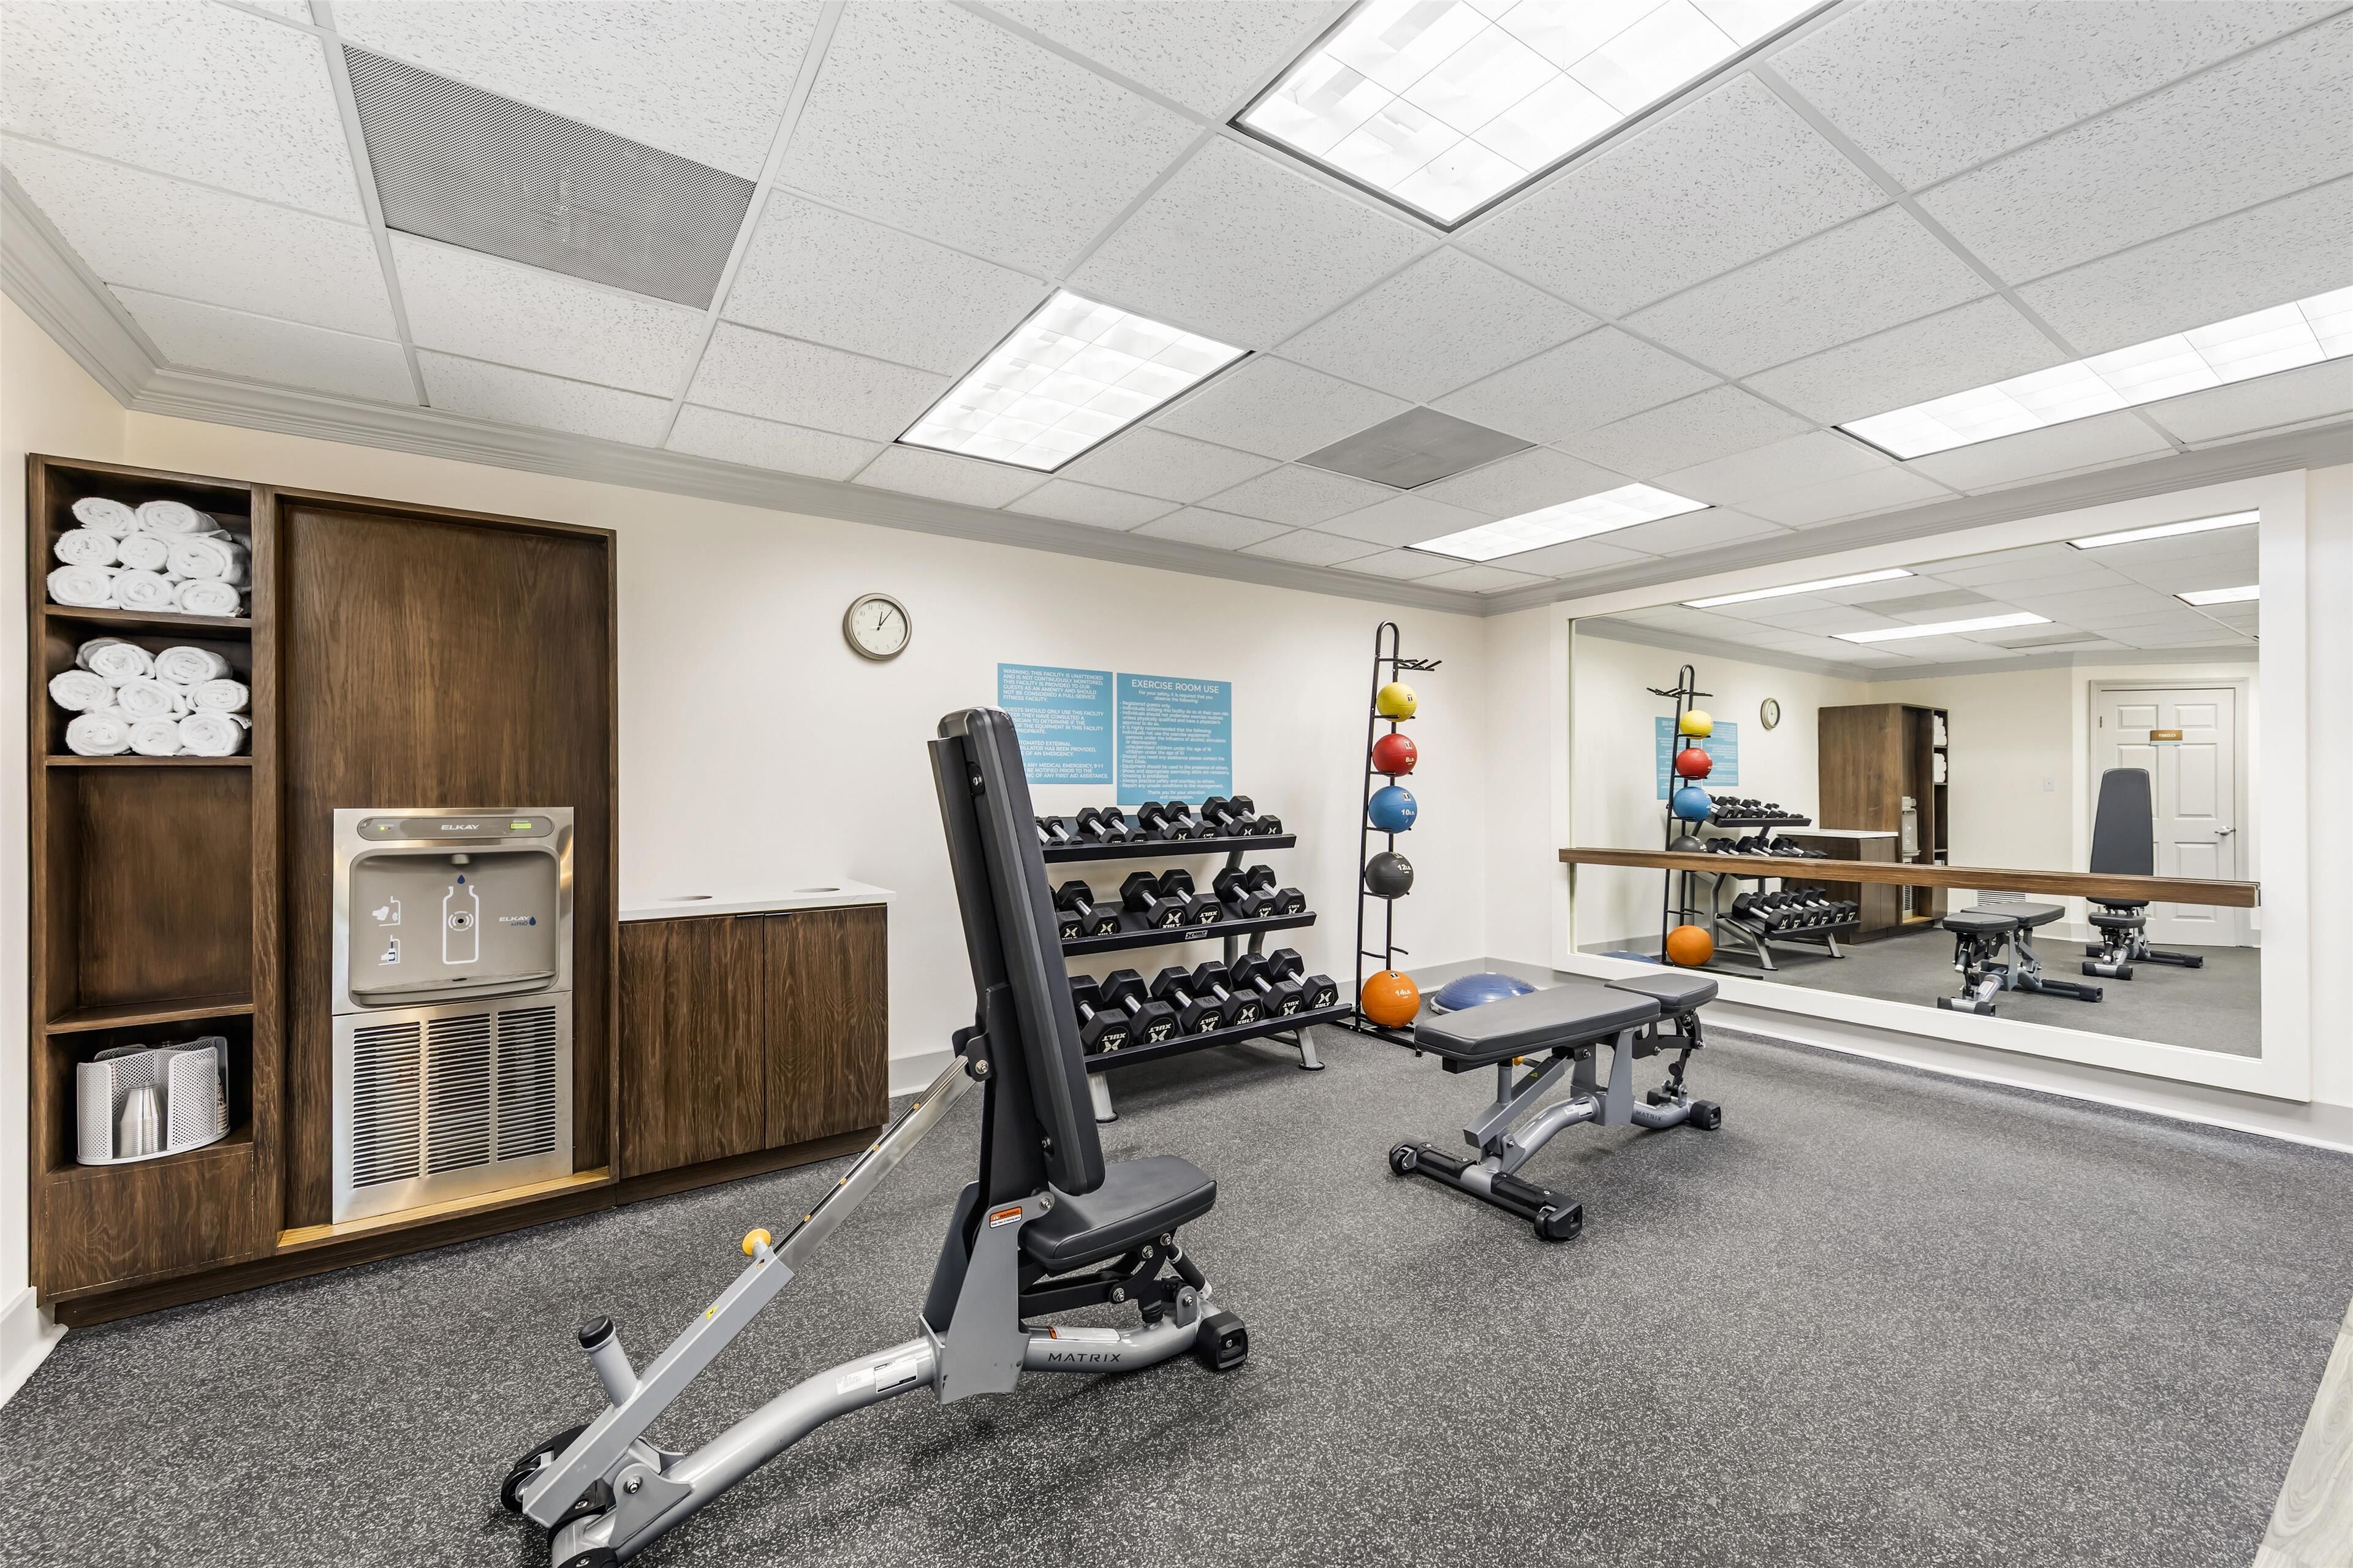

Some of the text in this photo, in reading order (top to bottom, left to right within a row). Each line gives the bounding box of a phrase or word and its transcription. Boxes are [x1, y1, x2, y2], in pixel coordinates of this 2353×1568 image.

[1132, 680, 1219, 694] EXERCISE ROOM USE
[1199, 1016, 1219, 1025] XULT
[1148, 1023, 1172, 1033] XULT
[1102, 1032, 1126, 1042] XULT
[1636, 1110, 1661, 1121] MATRIX
[999, 1210, 1020, 1218] WARNING
[1048, 1353, 1121, 1362] MATRIX
